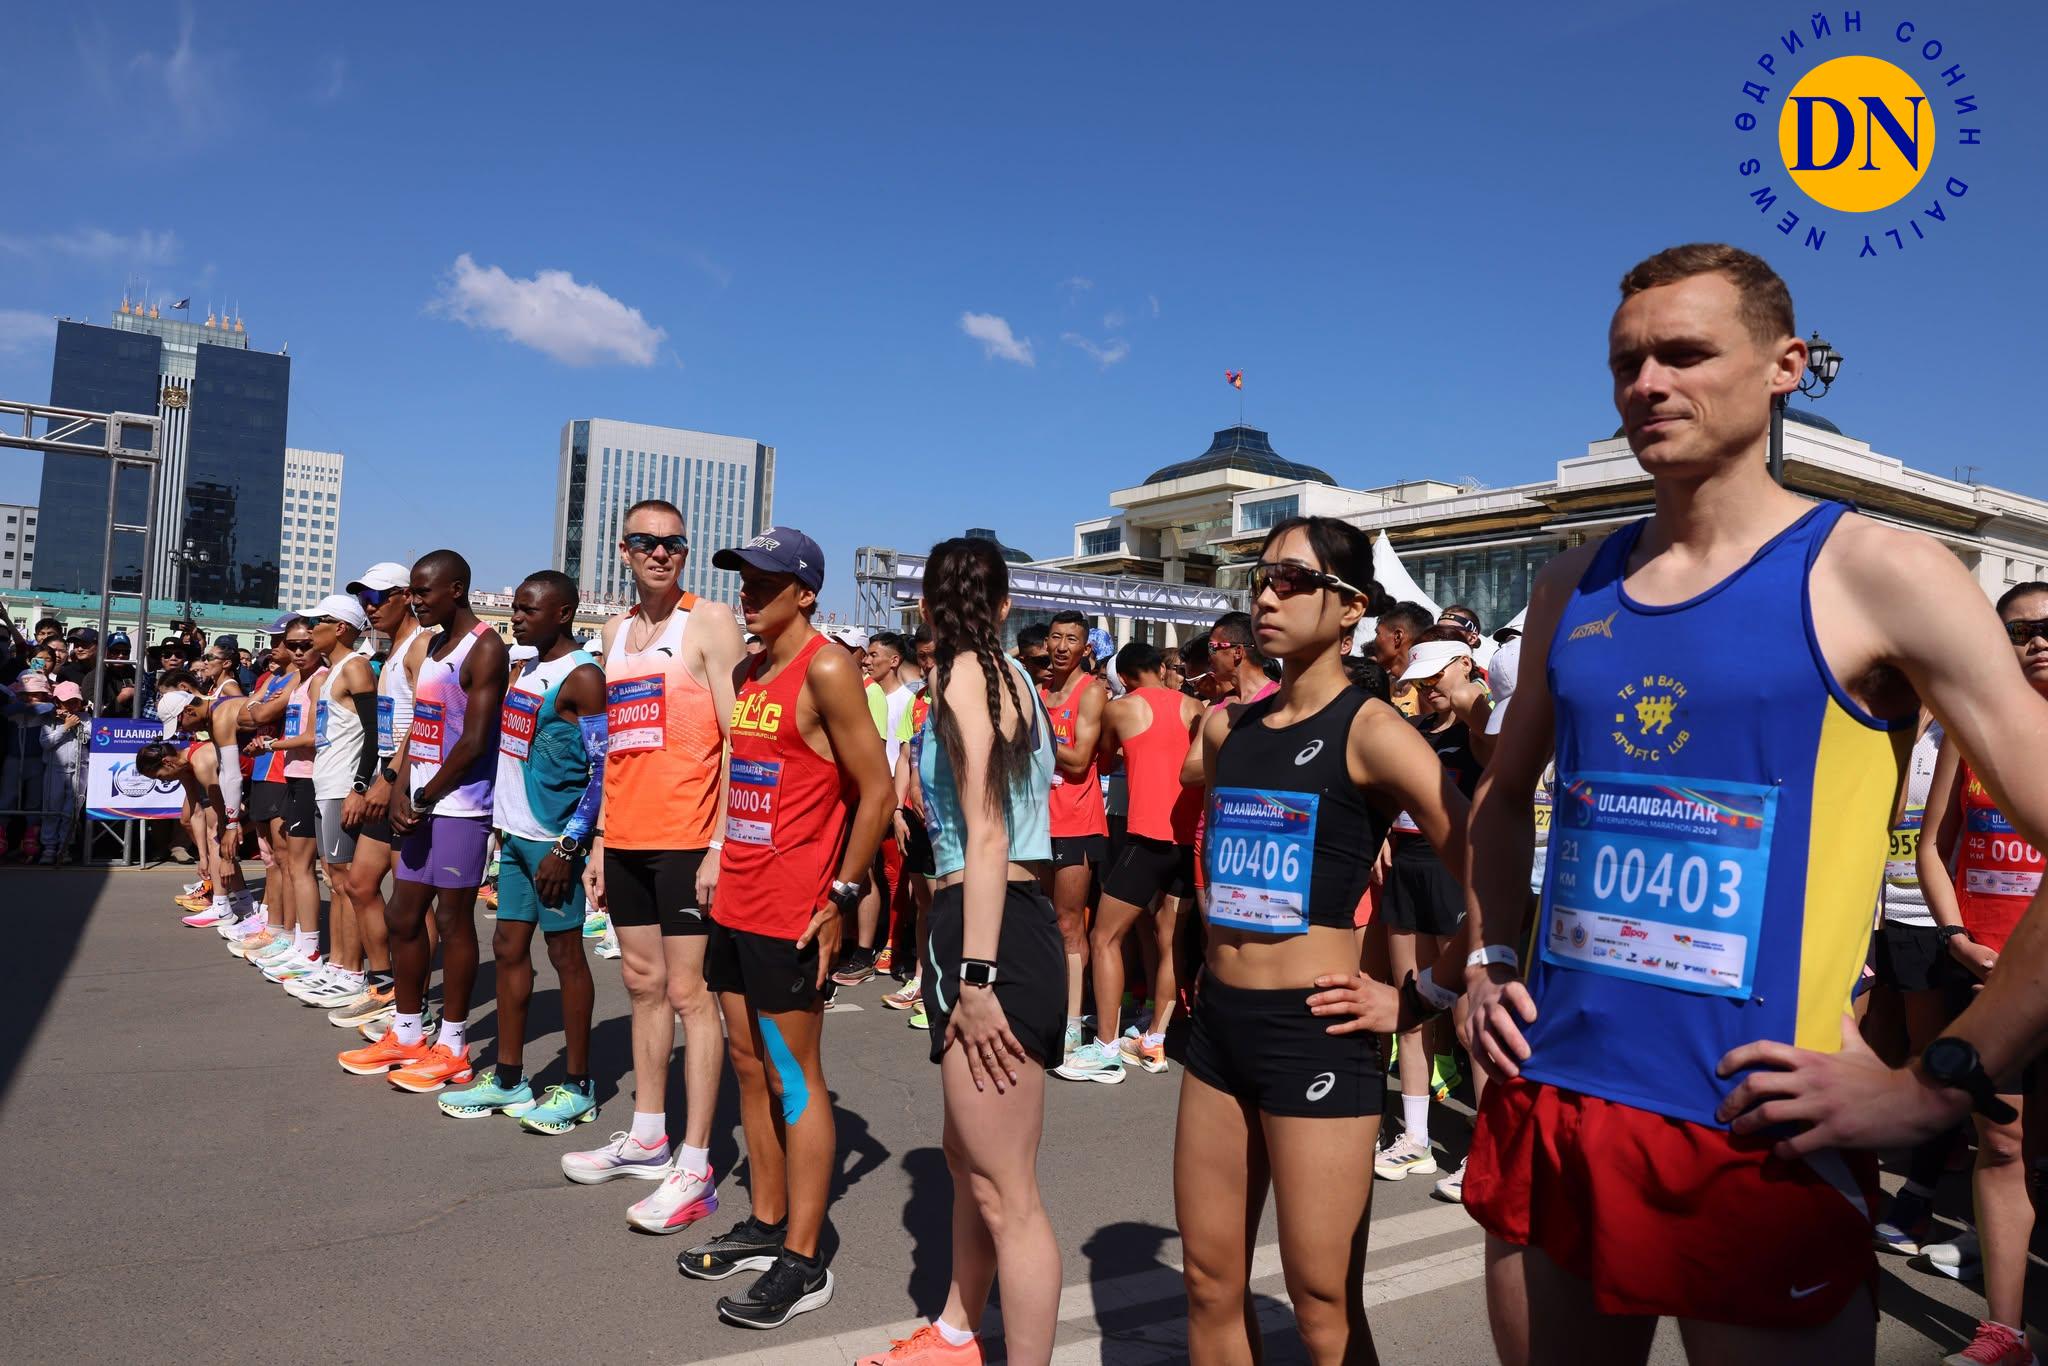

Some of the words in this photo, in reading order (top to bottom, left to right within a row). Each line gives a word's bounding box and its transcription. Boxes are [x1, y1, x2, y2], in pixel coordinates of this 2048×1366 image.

[507, 712, 531, 735] 00003
[617, 702, 660, 725] 00009
[729, 787, 772, 814] 00004
[1223, 801, 1285, 819] ULAANBAATAR
[1598, 793, 1719, 824] ULAANBAATAR
[1596, 816, 1649, 829] INTERNATIONAL
[1649, 820, 1692, 833] MARATHON
[1691, 826, 1718, 836] 2024
[1969, 837, 1986, 849] 42
[1218, 837, 1301, 883] 00406
[1970, 852, 1985, 860] KM
[1559, 870, 1576, 887] KM
[1561, 839, 1580, 863] 21
[1593, 844, 1743, 919] 00403
